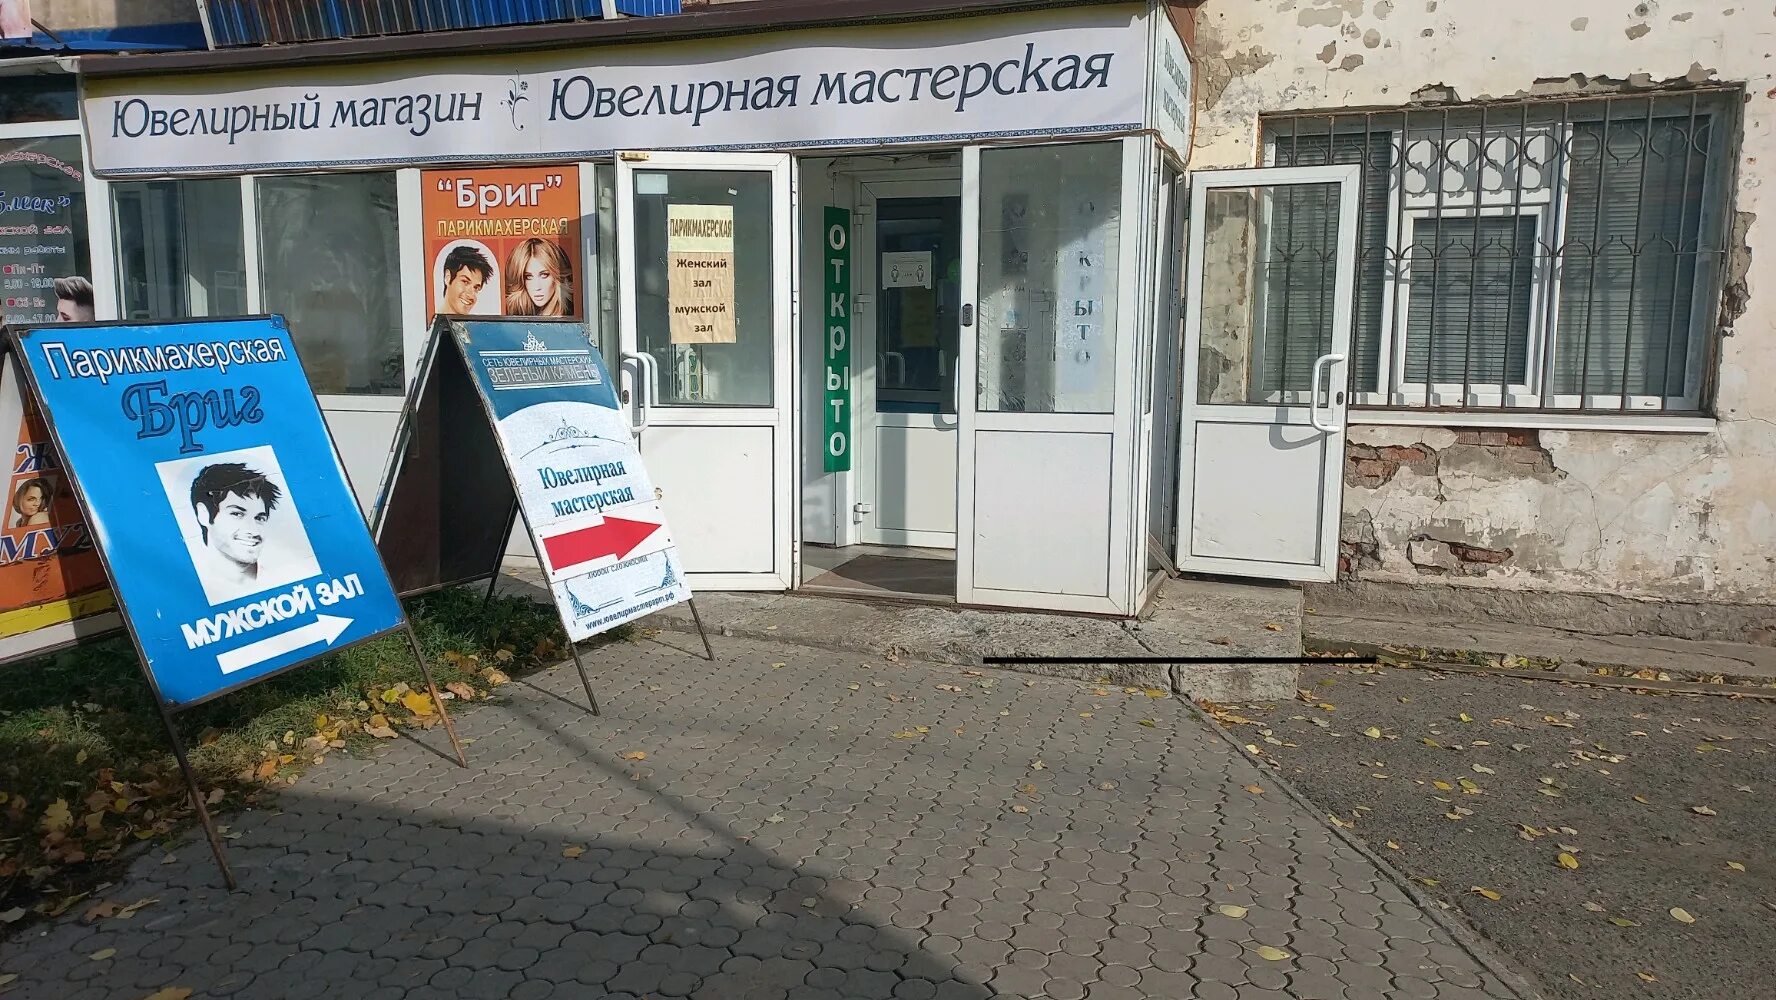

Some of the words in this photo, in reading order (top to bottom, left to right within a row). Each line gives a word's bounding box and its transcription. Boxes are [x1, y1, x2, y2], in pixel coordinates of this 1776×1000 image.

[547, 71, 800, 126] Ювелирная
[810, 41, 1115, 112] мастерская
[111, 93, 320, 145] Ювелирный
[330, 92, 482, 137] магазин
[437, 174, 563, 215] “Бриг”
[437, 218, 568, 238] ПАРИКМАХЕРСКАЯ
[670, 218, 732, 238] ПАРИКМАХЕРСКАЯ
[676, 258, 727, 269] Женский
[693, 279, 712, 288] зал
[675, 303, 726, 315] мужской
[694, 324, 713, 333] зал
[41, 337, 288, 385] Парикмахерская
[482, 357, 503, 367] СЕТЬ
[121, 378, 264, 455] Бриг
[537, 461, 627, 489] Ювелирная
[551, 486, 635, 518] мастерская
[180, 584, 317, 650] МУЖСКОЙ
[315, 573, 365, 606] ЗАЛ
